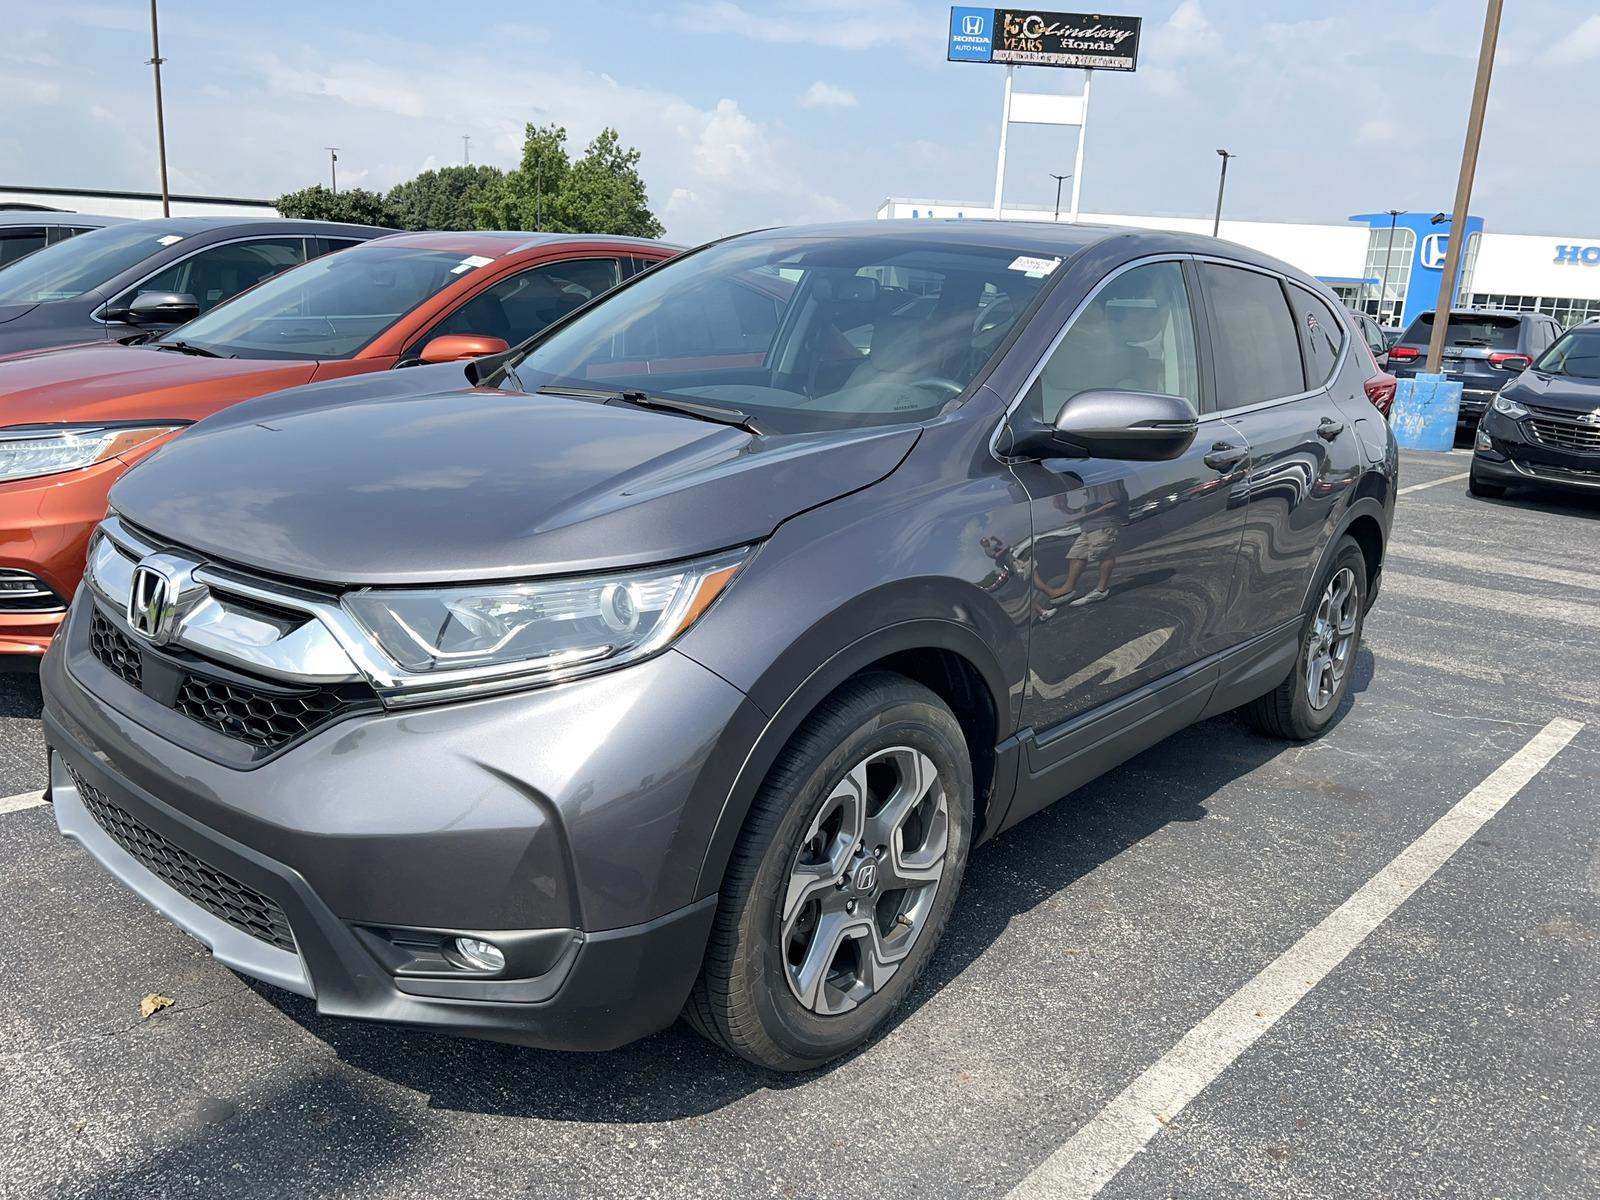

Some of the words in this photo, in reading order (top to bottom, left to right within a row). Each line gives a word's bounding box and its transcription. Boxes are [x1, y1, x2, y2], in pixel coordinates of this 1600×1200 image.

[953, 35, 992, 44] HONDA
[1045, 22, 1135, 44] Lindsay
[1004, 38, 1043, 51] YEARS
[1060, 38, 1116, 51] Honda
